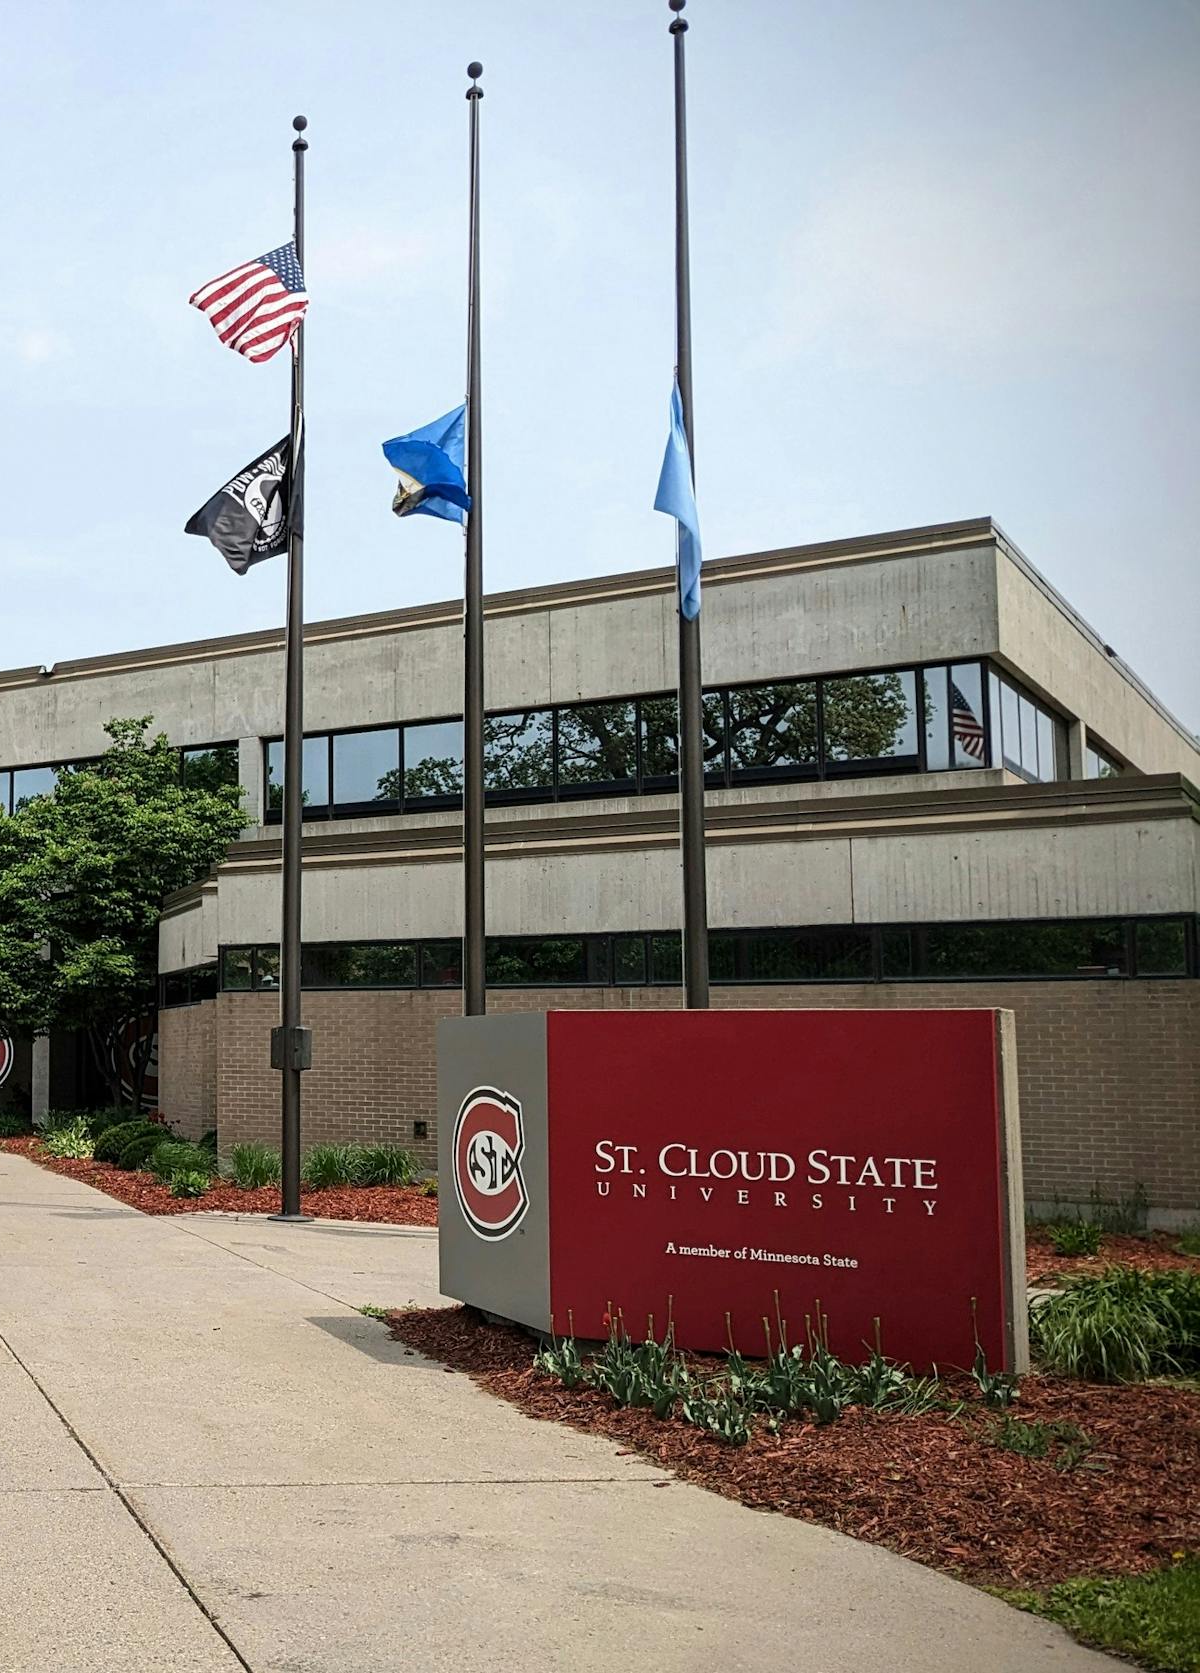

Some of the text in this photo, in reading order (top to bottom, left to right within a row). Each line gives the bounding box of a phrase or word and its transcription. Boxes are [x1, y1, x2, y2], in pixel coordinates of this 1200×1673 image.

[595, 1140, 939, 1190] ST. CLOUD STATE
[597, 1181, 938, 1216] UNIVERSITY
[665, 1242, 859, 1269] A member of Minnesota State
